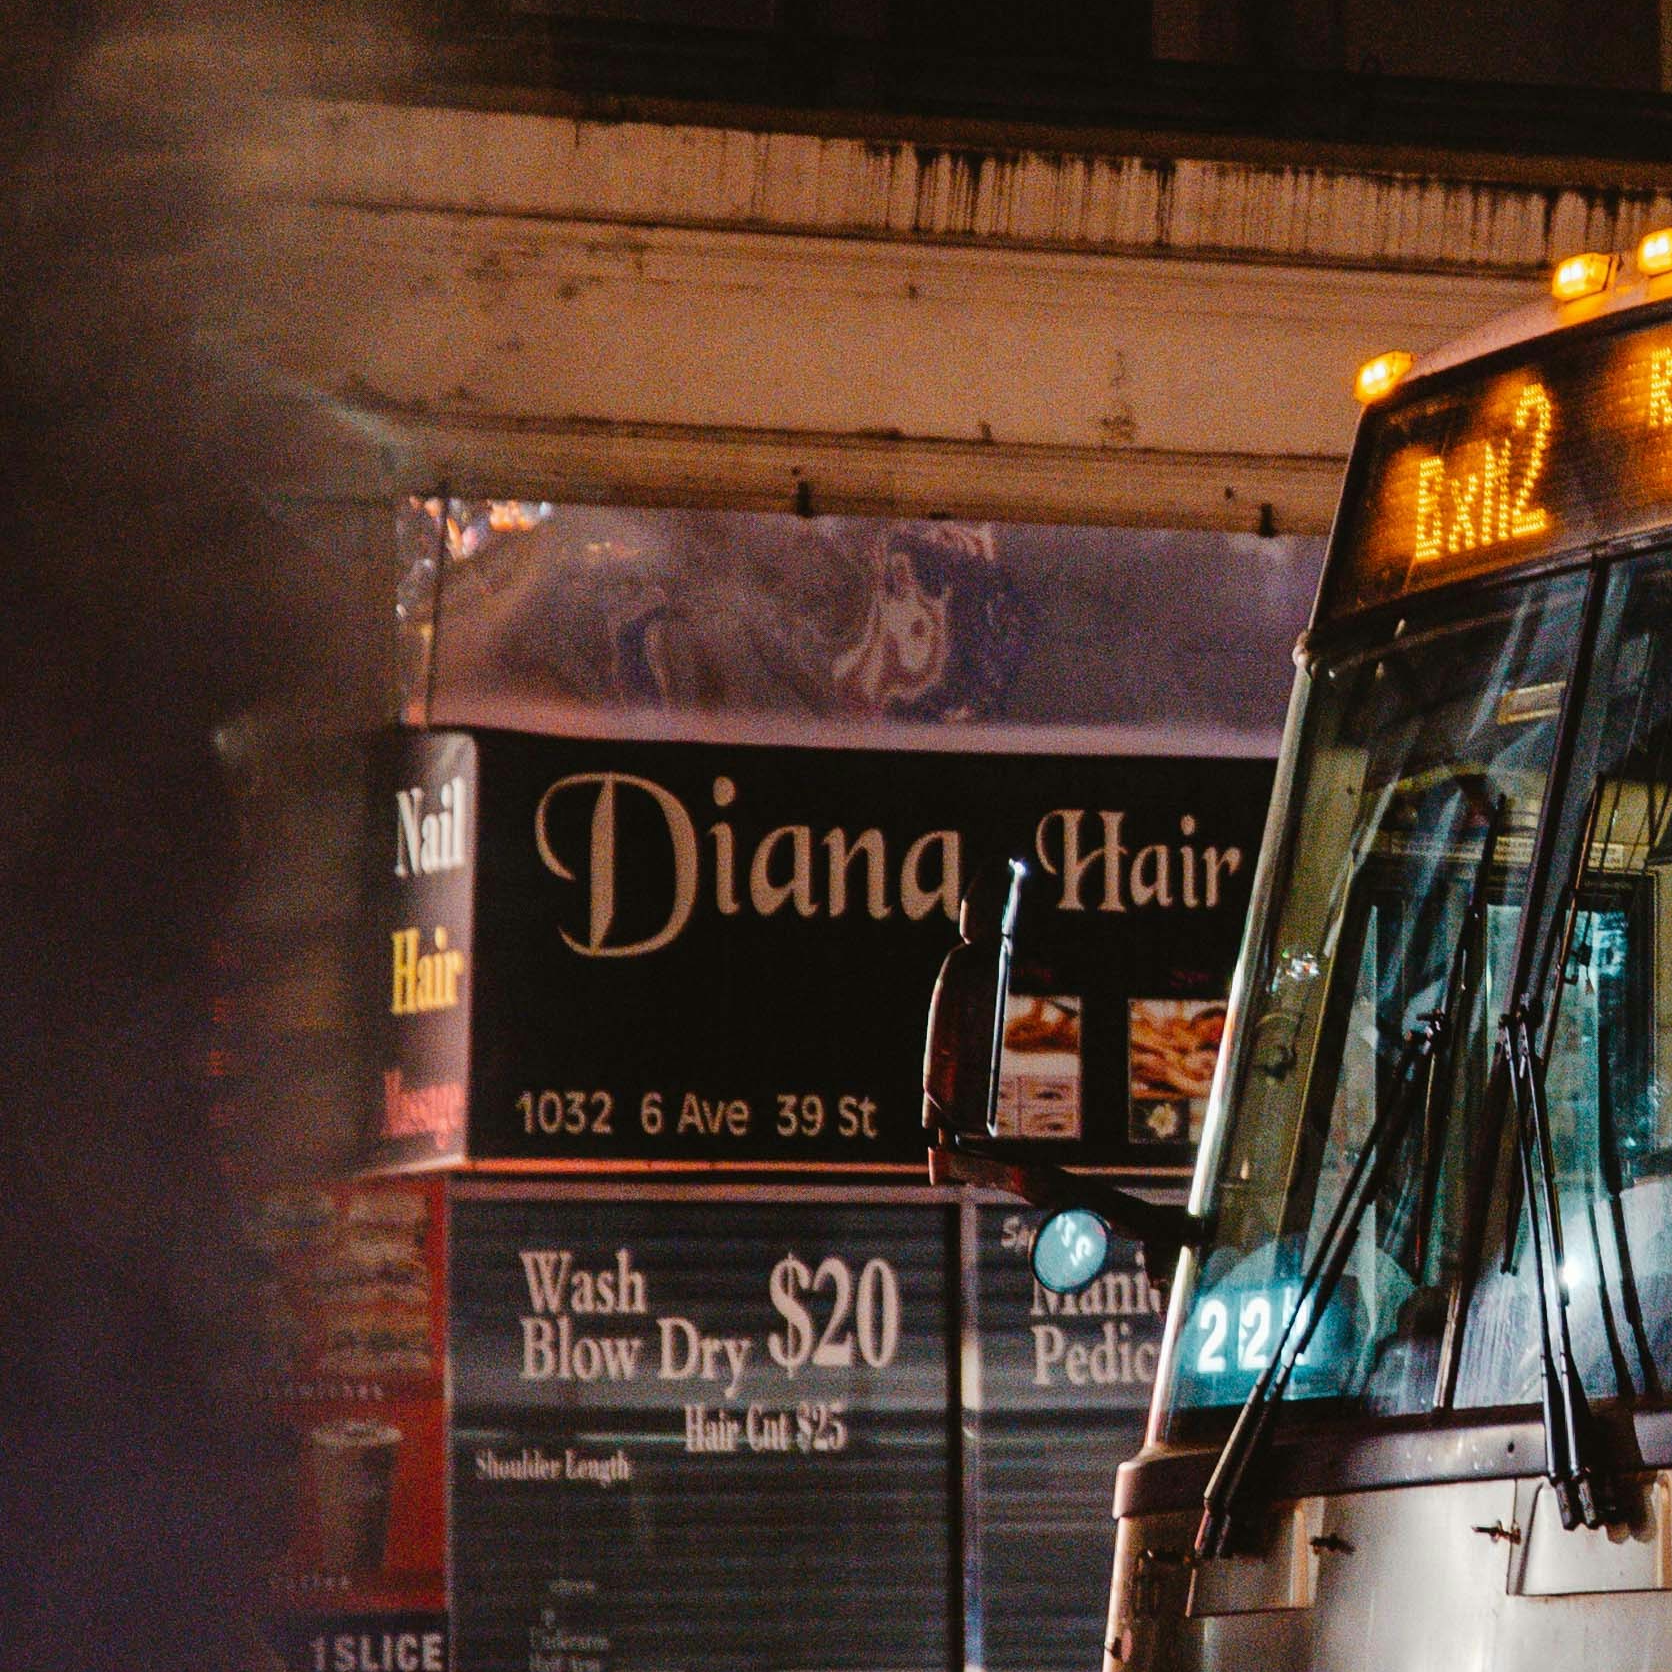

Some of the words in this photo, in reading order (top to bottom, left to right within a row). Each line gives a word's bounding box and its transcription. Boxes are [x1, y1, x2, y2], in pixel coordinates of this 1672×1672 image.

[395, 776, 465, 877] Nail
[535, 771, 961, 957] Diana
[1036, 809, 1241, 912] Hair
[391, 926, 464, 1015] Hair
[515, 1089, 613, 1135] 1032
[640, 1091, 664, 1135] 6
[677, 1092, 750, 1137] Ave
[776, 1093, 825, 1137] 39
[837, 1094, 878, 1139] St
[519, 1248, 648, 1315] Wash
[767, 1251, 899, 1379] $20
[519, 1315, 643, 1381] Blow
[656, 1316, 752, 1399] Dry
[476, 1448, 561, 1480] Shoulder
[565, 1447, 633, 1487] Length
[685, 1402, 740, 1453] Hair
[745, 1402, 791, 1452] Cut
[796, 1399, 849, 1453] $25
